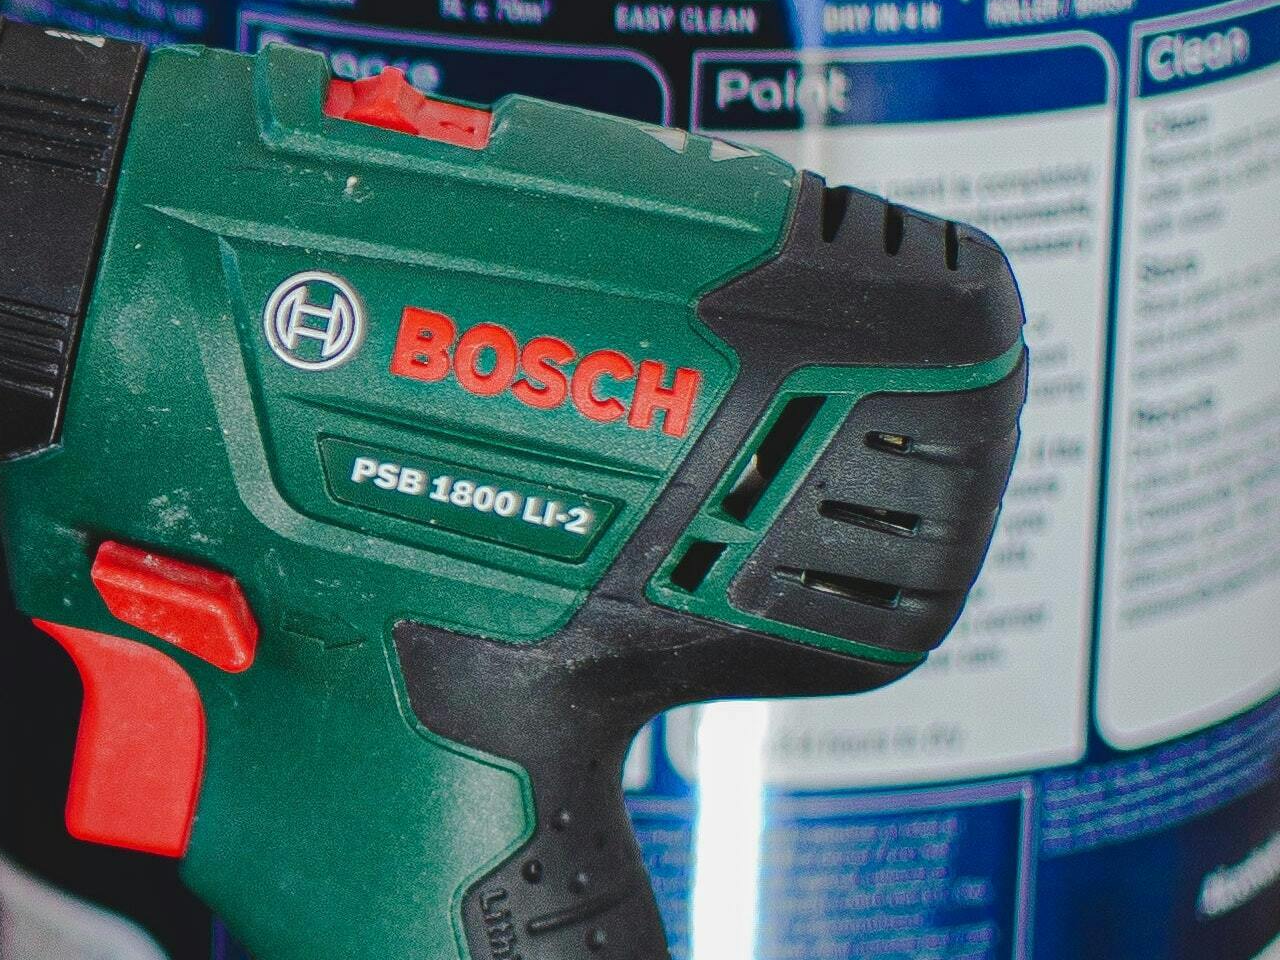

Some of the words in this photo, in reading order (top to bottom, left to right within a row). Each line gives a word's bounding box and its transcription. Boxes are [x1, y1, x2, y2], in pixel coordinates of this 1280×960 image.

[615, 1, 675, 33] EASY
[680, 3, 758, 33] CLEAN
[823, 3, 870, 33] DRY
[874, 0, 900, 32] IN
[1148, 26, 1250, 82] Clean
[718, 69, 848, 112] Paint
[389, 305, 702, 439] BOSCH
[350, 456, 428, 496] PSB
[429, 475, 522, 517] 1800
[522, 496, 595, 535] LI-2
